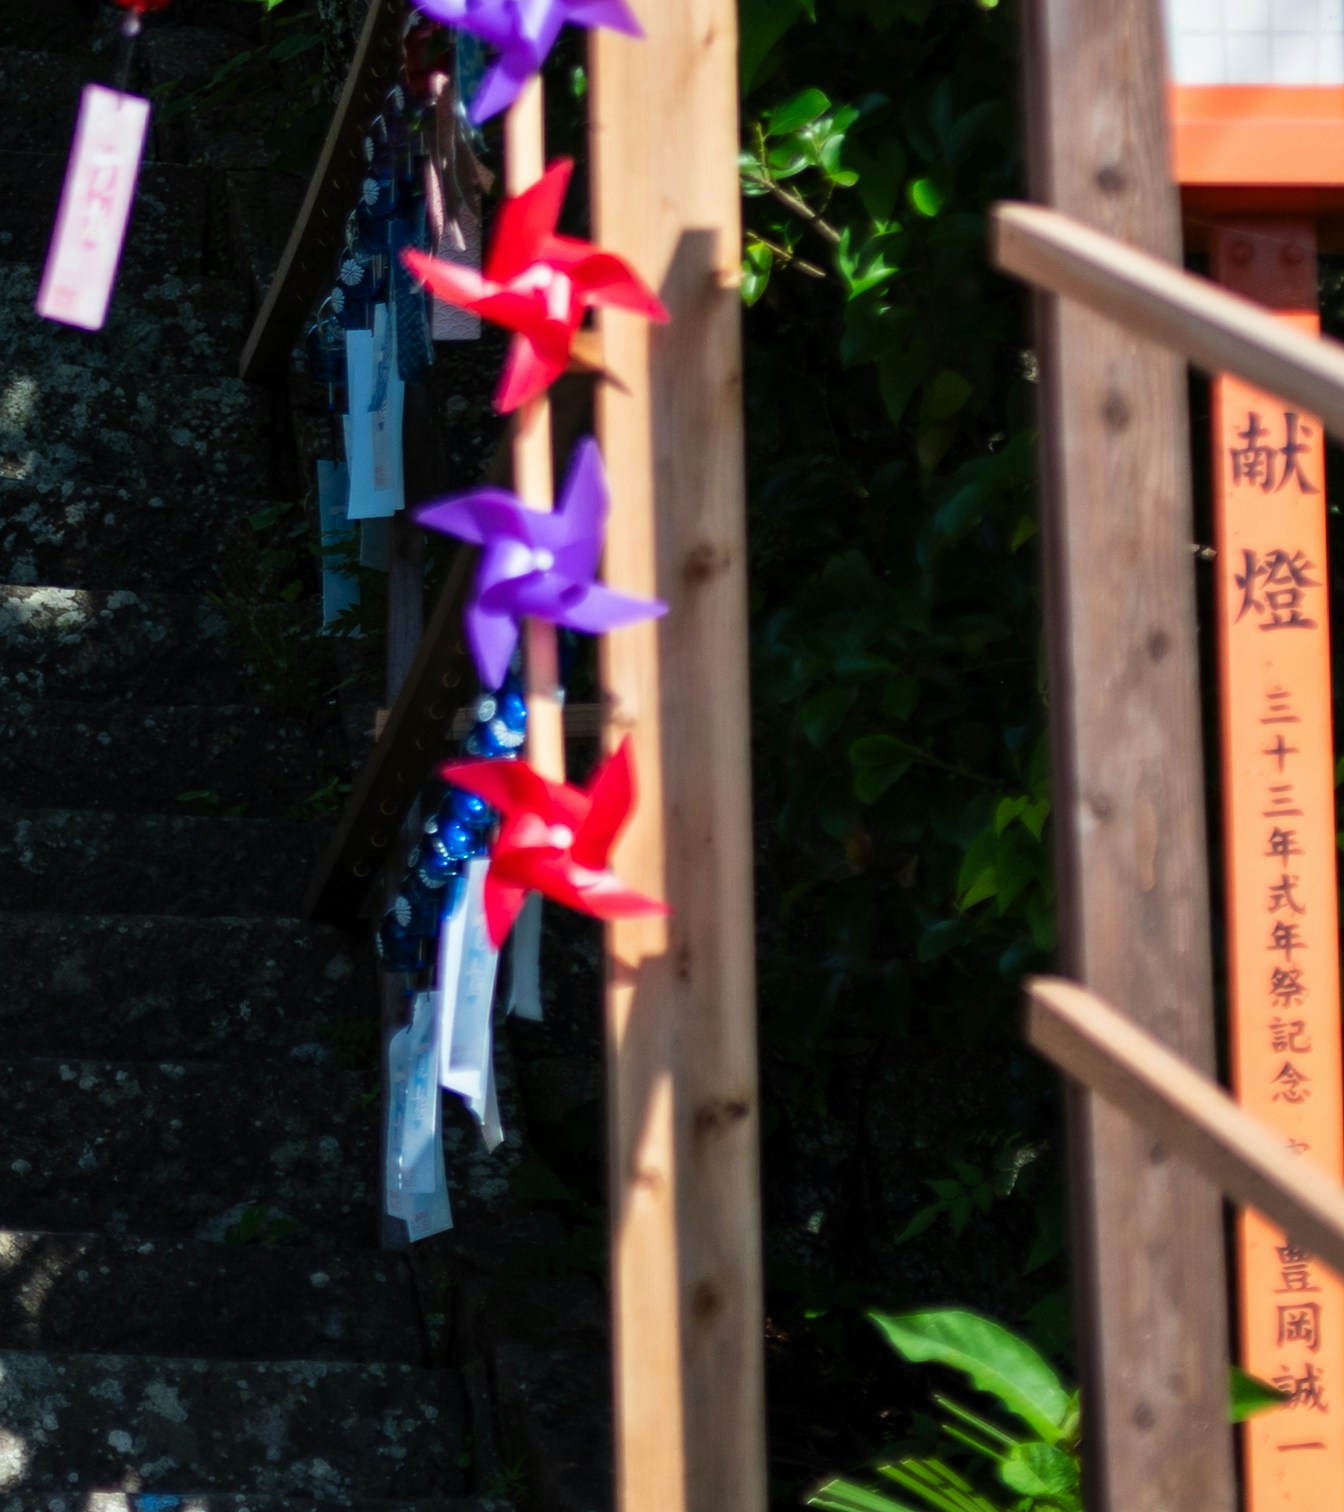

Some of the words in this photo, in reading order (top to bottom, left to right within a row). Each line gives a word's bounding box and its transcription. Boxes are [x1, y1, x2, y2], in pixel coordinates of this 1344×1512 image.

[1229, 411, 1323, 632] 献燈
[1259, 690, 1313, 1104] 三十三年式年祭記念
